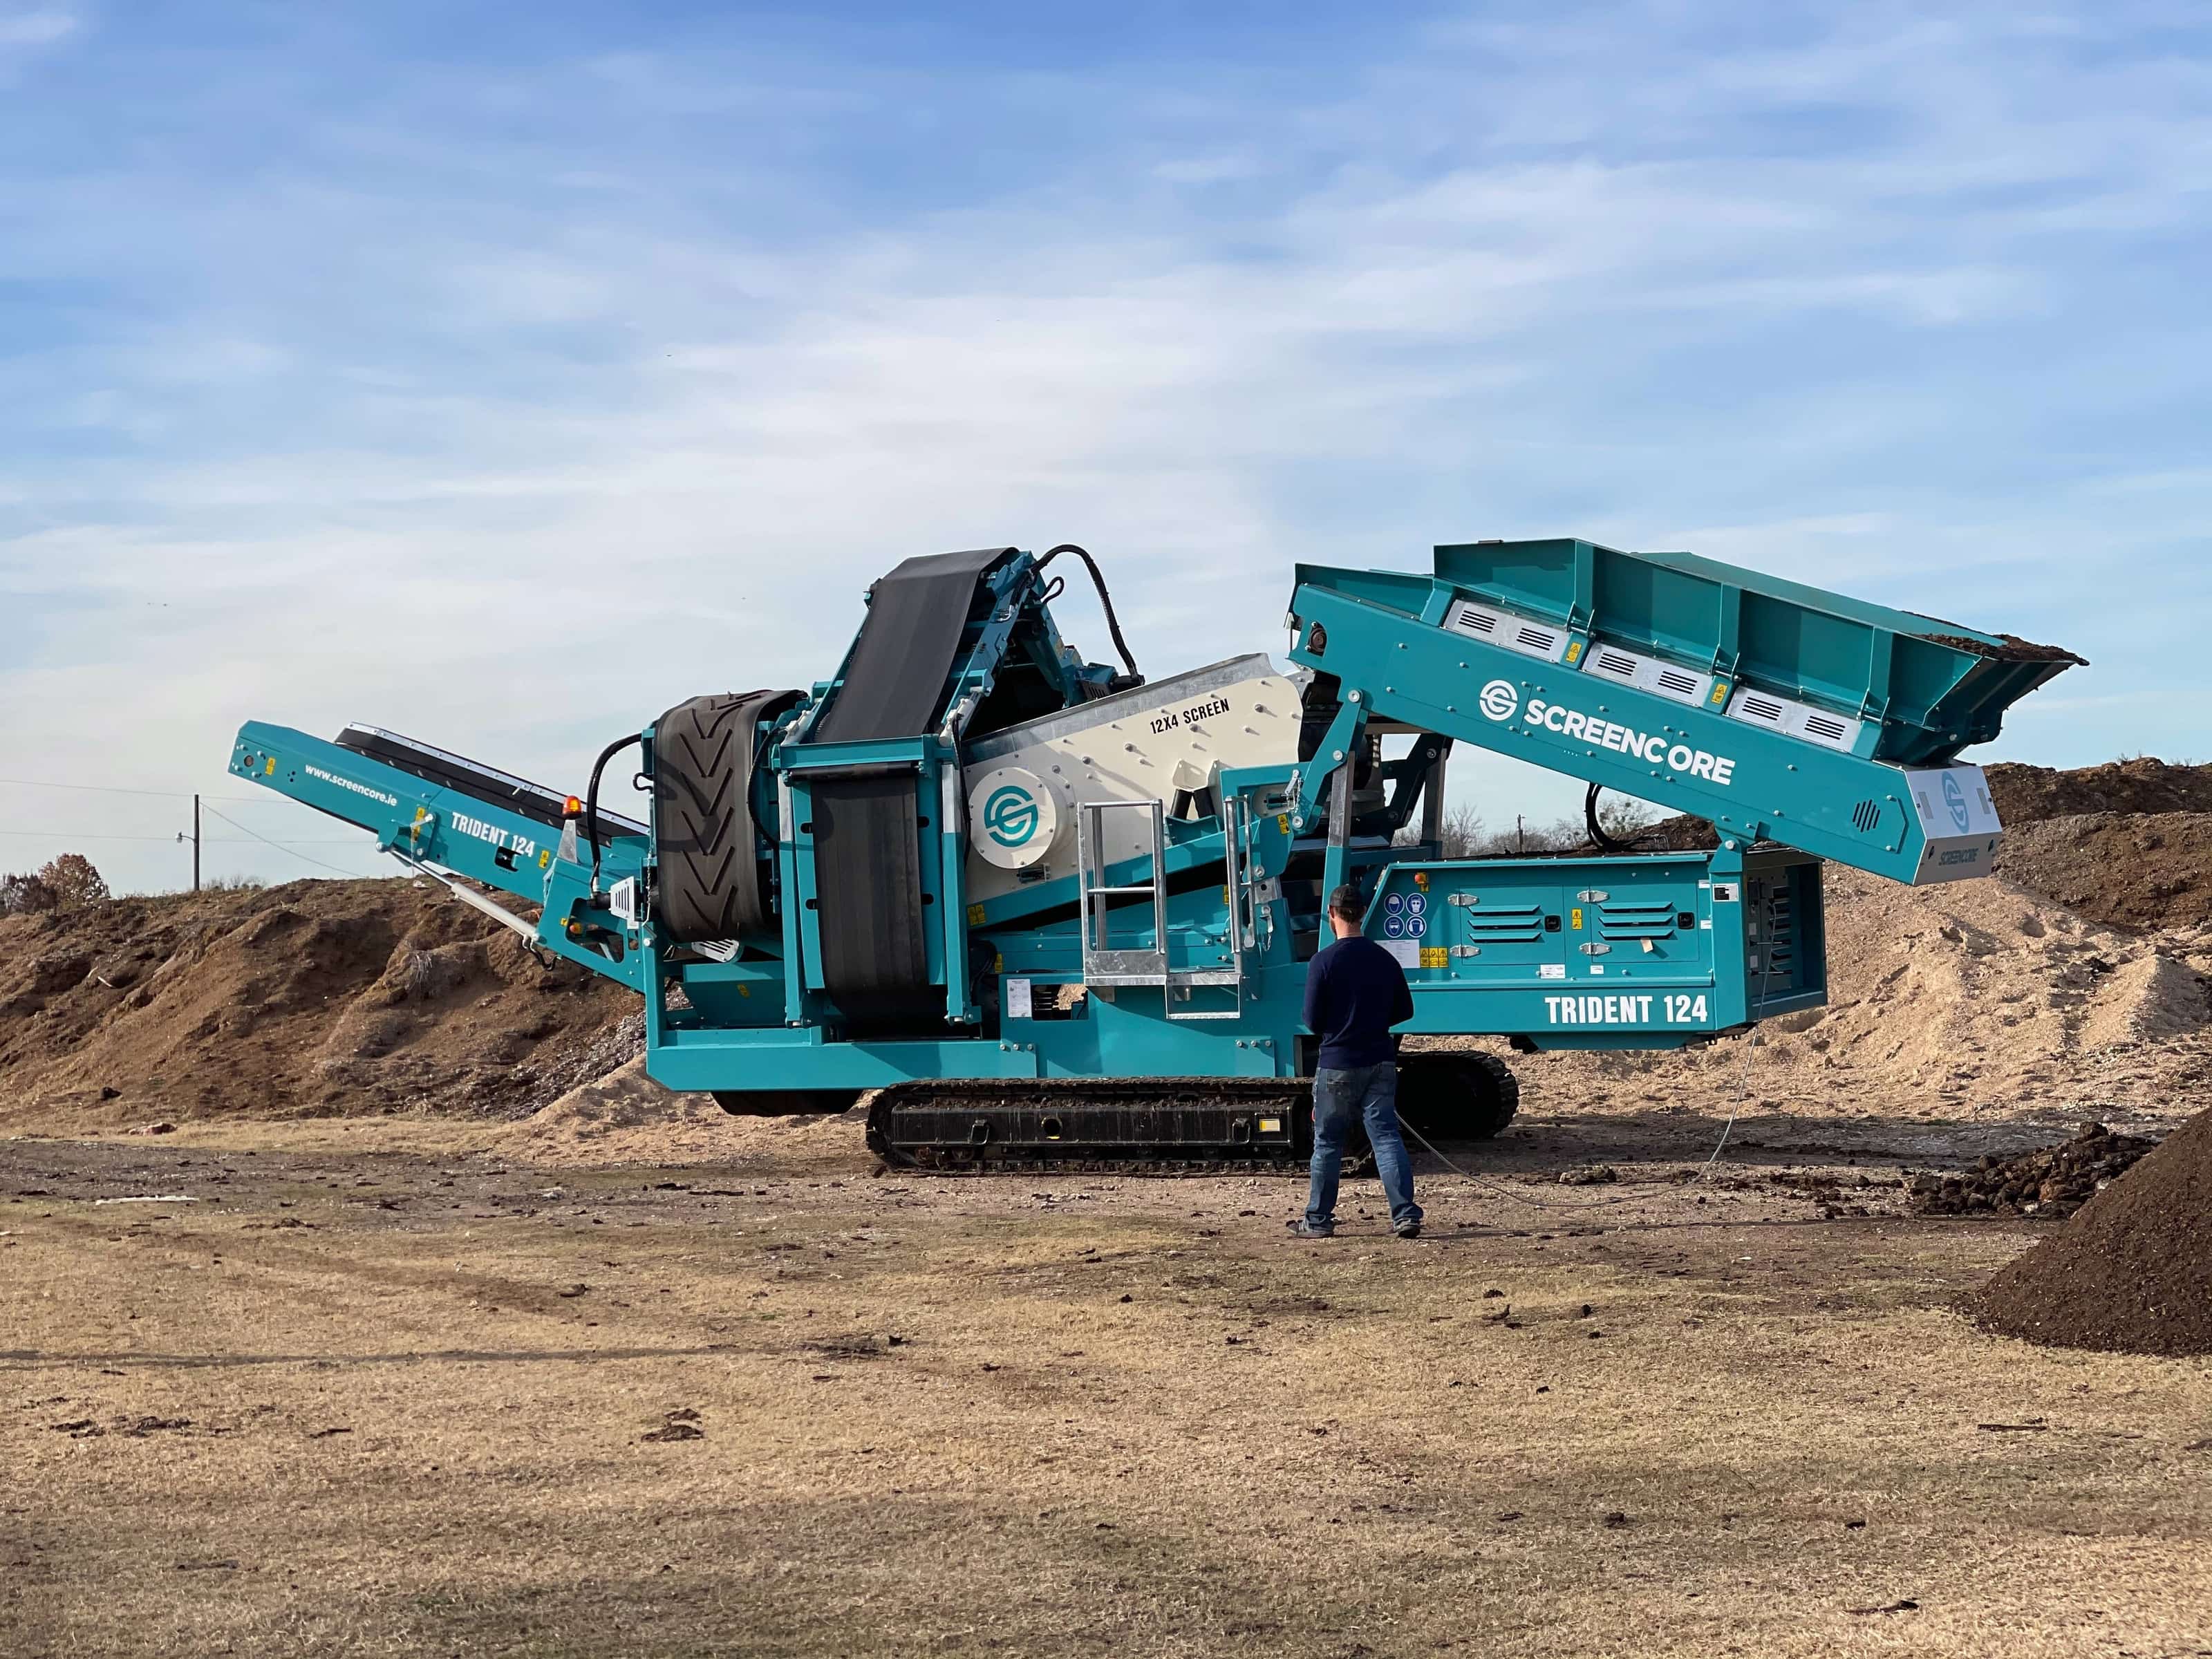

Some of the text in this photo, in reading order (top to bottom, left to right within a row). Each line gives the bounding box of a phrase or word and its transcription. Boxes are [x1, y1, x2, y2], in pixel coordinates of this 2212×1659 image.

[1150, 698, 1230, 734] 12X4 SCREEN
[1524, 699, 1736, 786] SCREENCORE
[305, 764, 397, 807] www.screencore.ie
[451, 812, 535, 857] TRIDENT 124
[1544, 995, 1708, 1024] TRIDENT 124
